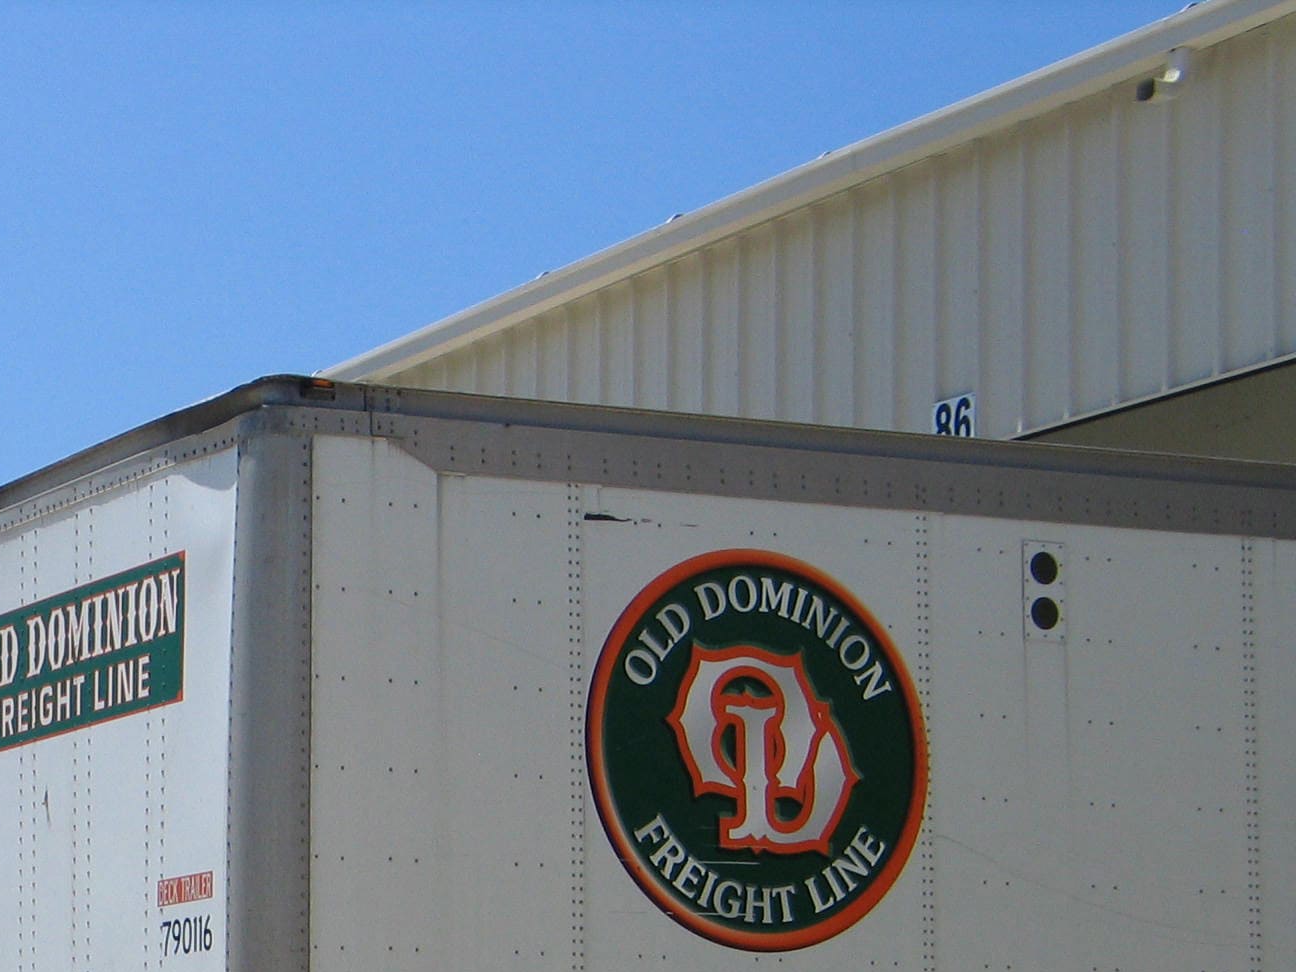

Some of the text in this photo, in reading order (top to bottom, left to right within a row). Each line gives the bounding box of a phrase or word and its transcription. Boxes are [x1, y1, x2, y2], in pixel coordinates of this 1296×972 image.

[26, 568, 182, 679] DOMINION
[624, 574, 894, 702] OLD DOMINION
[93, 655, 151, 711] LINE
[633, 814, 886, 924] FREIGHT LINE
[162, 914, 213, 957] 790116
